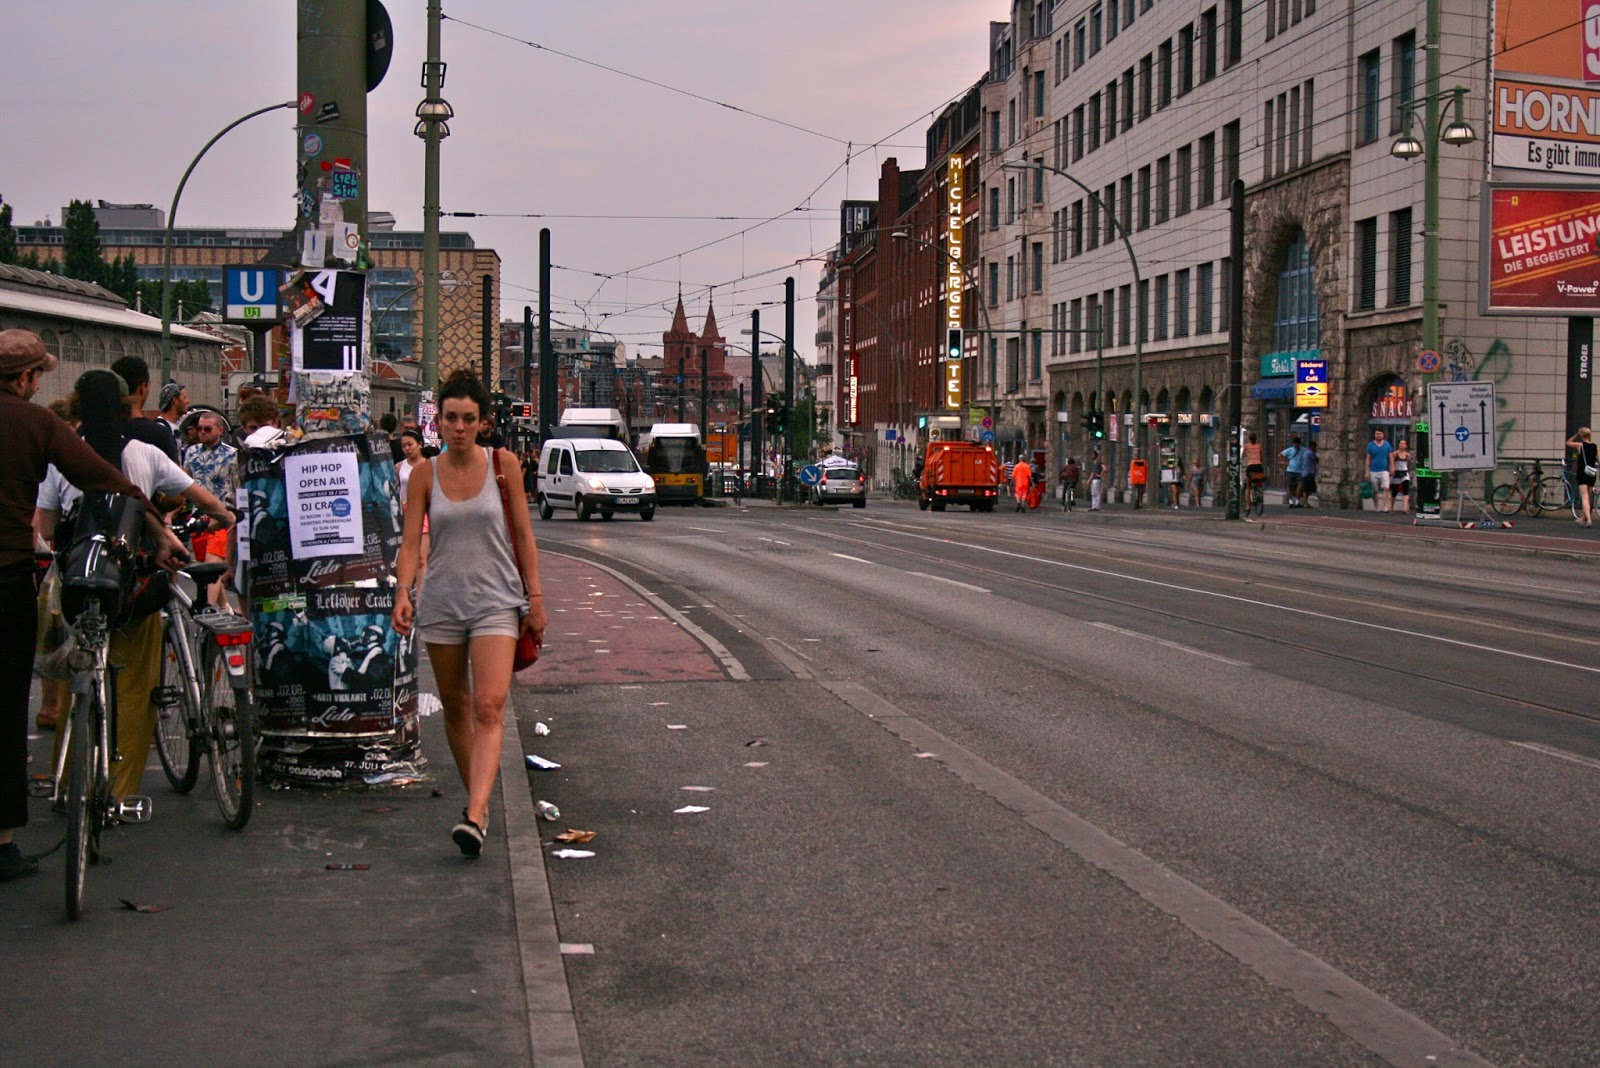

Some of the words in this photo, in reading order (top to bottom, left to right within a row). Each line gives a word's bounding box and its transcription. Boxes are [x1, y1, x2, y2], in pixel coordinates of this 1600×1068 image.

[1499, 87, 1600, 136] HORN
[1528, 141, 1542, 163] Es
[1546, 144, 1570, 169] gibt
[1504, 260, 1523, 274] DIE
[1526, 243, 1590, 268] BEGEISTERT
[240, 271, 264, 303] U
[1557, 284, 1597, 293] V-Power
[1371, 400, 1413, 417] SNACK
[301, 465, 318, 474] HIP
[321, 463, 342, 472] HOP
[300, 479, 327, 488] OPEN
[329, 477, 346, 486] AIR
[301, 503, 312, 512] DJ
[315, 501, 333, 510] CRA
[300, 560, 343, 584] Lido
[365, 592, 393, 609] Crack
[312, 705, 356, 727] Lido
[359, 760, 379, 770] JULI
